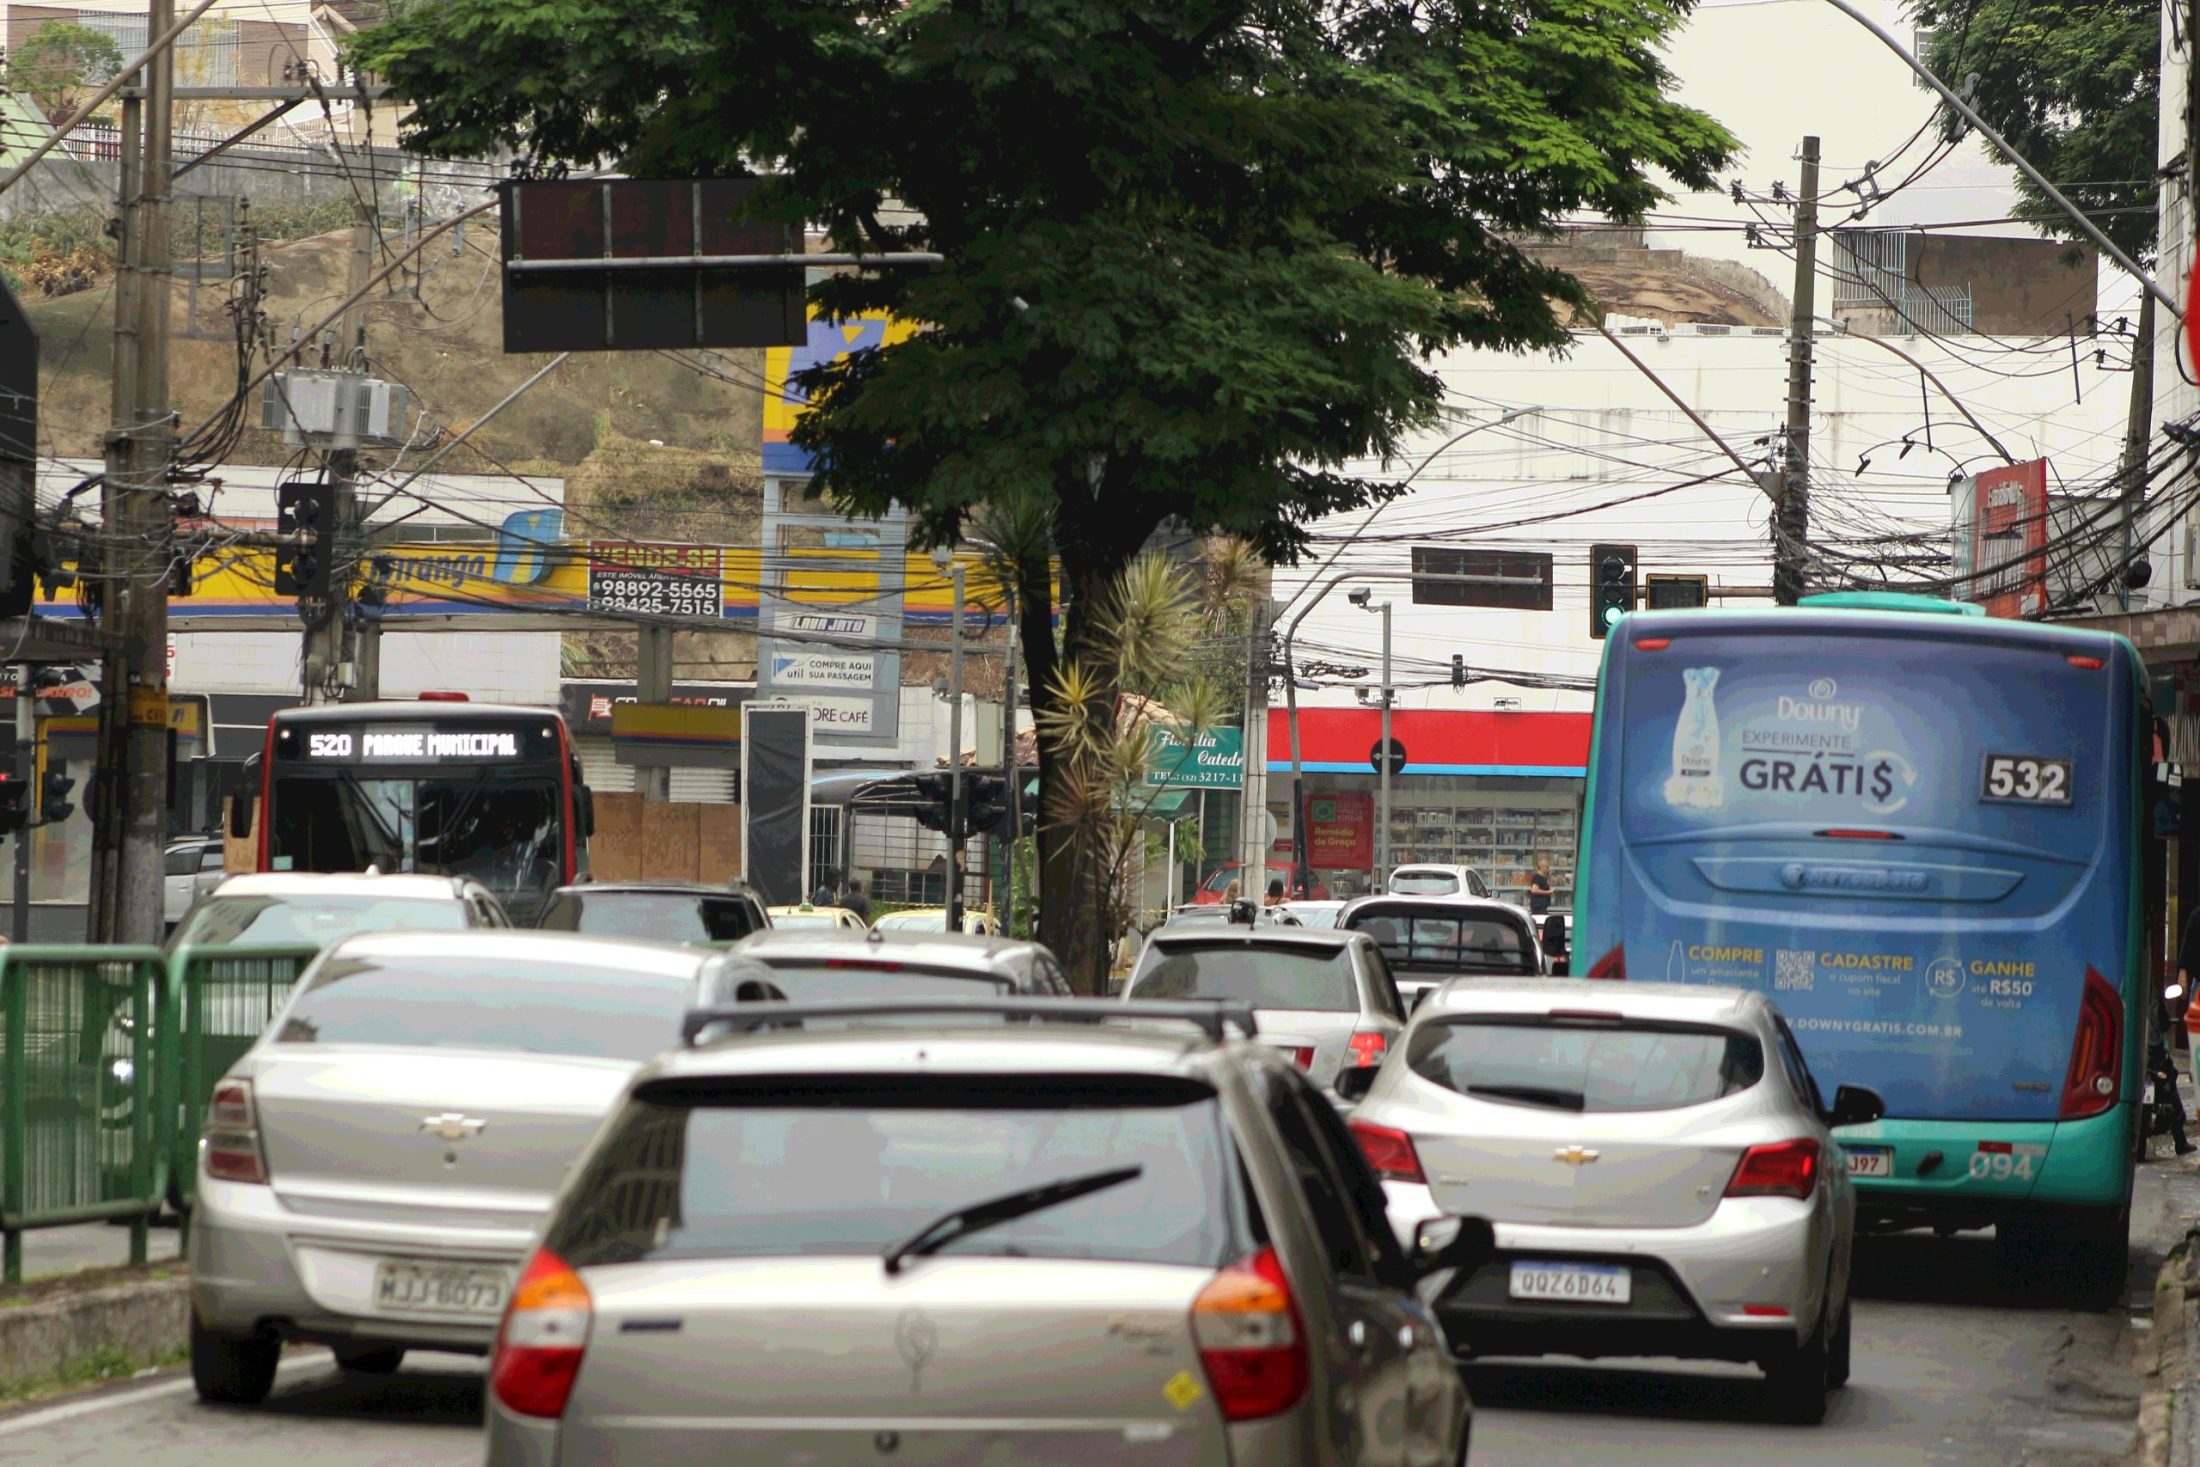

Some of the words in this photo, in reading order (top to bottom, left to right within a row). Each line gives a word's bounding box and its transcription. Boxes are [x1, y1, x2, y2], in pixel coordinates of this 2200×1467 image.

[601, 580, 717, 599] 98892-5565
[601, 596, 715, 616] 98425-7515
[787, 668, 804, 679] util
[809, 660, 847, 670] COMPRE
[849, 662, 872, 672] AQUI
[808, 671, 825, 679] SUA
[827, 672, 872, 682] PASSAGEM
[839, 711, 868, 724] CAFÉ
[1777, 696, 1860, 731] Downy
[310, 734, 351, 757] 520
[363, 734, 424, 757] PARQUE
[427, 734, 517, 757] MUNICIPAL
[1742, 730, 1851, 749] EXPERIMENTE
[1198, 750, 1243, 766] Catedr
[1199, 772, 1243, 783] 3217-11
[1989, 758, 2065, 799] 532
[1314, 827, 1355, 837] Remédio
[1314, 838, 1326, 847] de
[1327, 837, 1357, 848] Graça
[1688, 945, 1764, 964] COMPRE
[1820, 952, 1914, 971] CADASTRE
[1970, 959, 2035, 977] GANHE
[1838, 973, 1873, 986] cupom
[1875, 972, 1901, 985] fiscal
[1934, 969, 1956, 987] R$
[1847, 987, 1860, 996] no
[1862, 987, 1881, 996] site
[1990, 979, 2033, 996] R$50
[1784, 1018, 1962, 1038] .DOWNYGRATIS.COM.BR
[1969, 1152, 2033, 1181] 094
